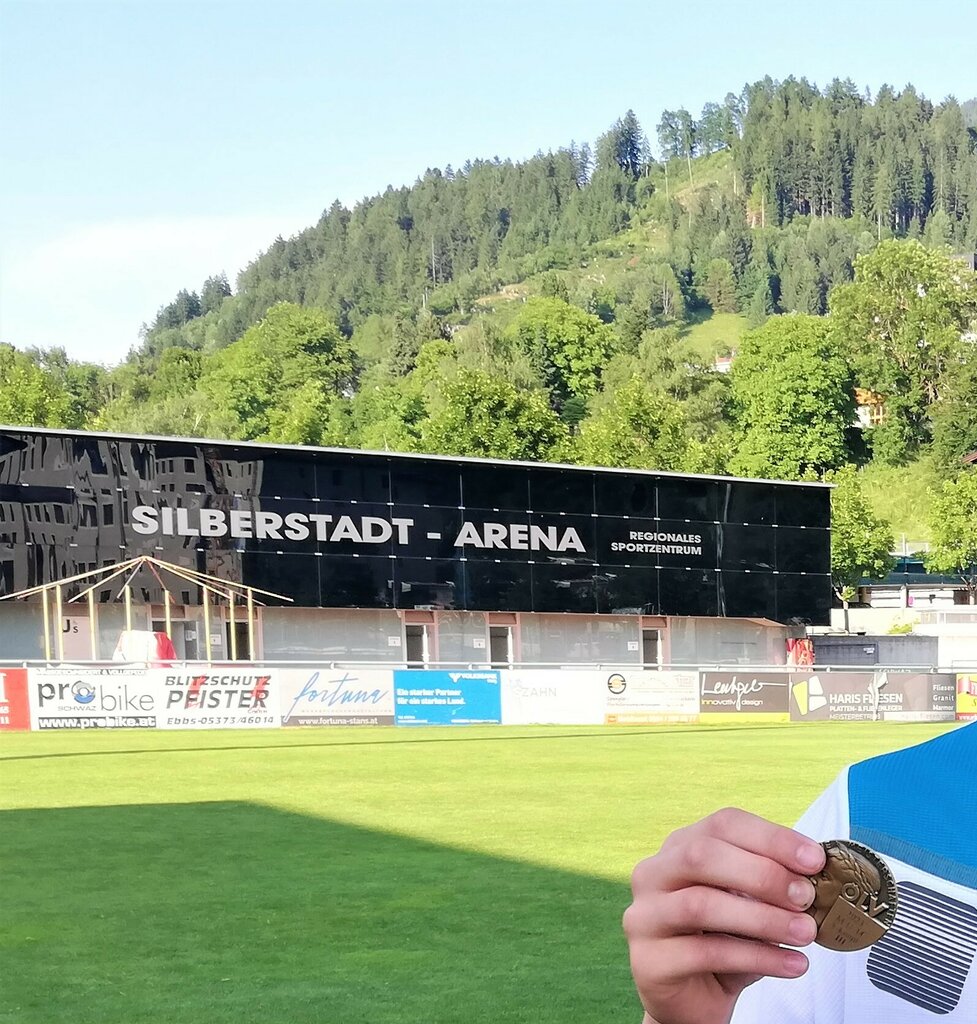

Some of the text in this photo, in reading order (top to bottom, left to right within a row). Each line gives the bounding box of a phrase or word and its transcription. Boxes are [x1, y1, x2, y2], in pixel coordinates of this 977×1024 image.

[132, 505, 414, 545] SILBERSTADT
[454, 522, 586, 552] ARENA
[629, 531, 701, 543] REGIONALES
[611, 542, 701, 555] SPORTZENTRUM
[165, 675, 271, 686] BLITZSCHUTZ
[283, 672, 389, 723] fortuna
[521, 687, 557, 697] ZAHN
[166, 690, 270, 709] PFISTER
[830, 693, 861, 704] HARIS
[932, 694, 955, 702] Granit
[39, 718, 156, 729] www.probike.at
